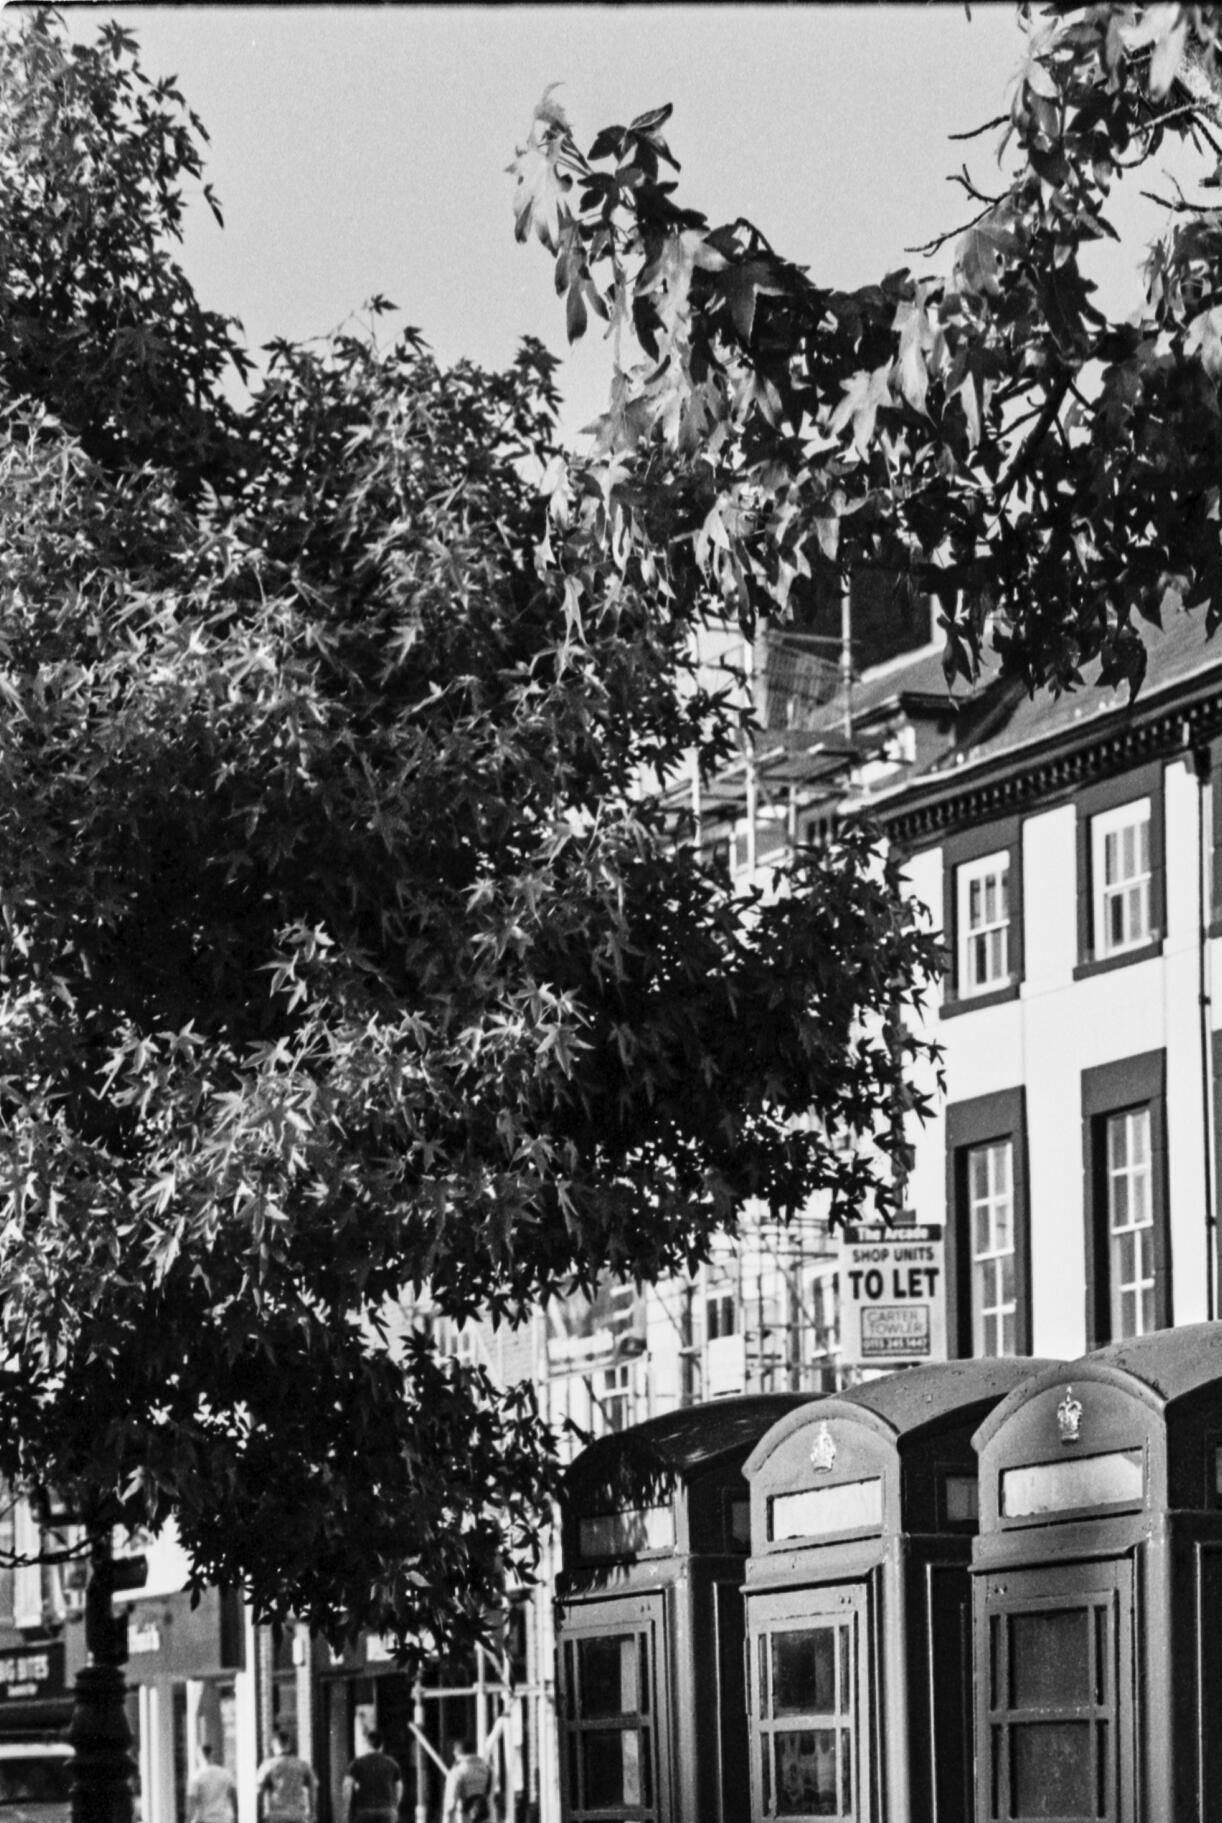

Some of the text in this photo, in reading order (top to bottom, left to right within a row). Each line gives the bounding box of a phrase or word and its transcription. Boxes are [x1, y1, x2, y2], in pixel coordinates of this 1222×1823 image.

[853, 1246, 934, 1263] SHOP UNITS
[848, 1267, 939, 1300] TO LET
